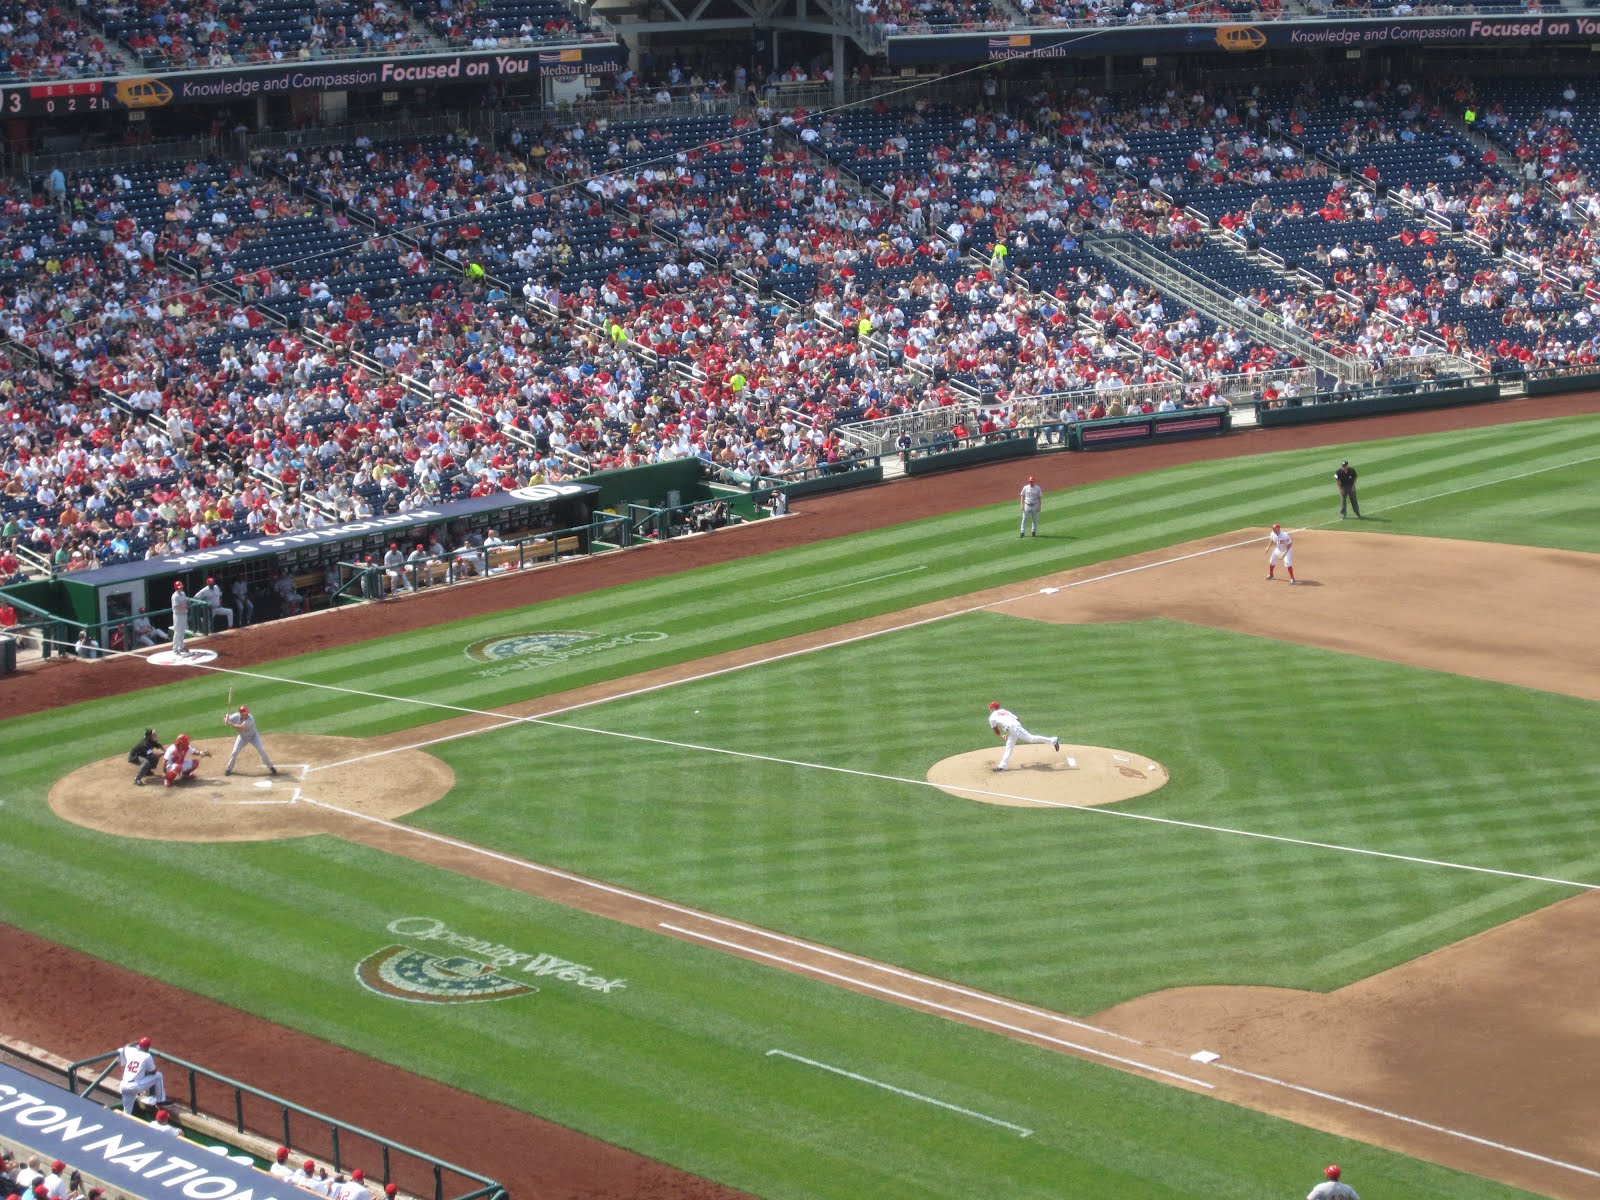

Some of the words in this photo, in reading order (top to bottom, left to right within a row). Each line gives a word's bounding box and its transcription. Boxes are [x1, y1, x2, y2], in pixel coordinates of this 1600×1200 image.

[1291, 28, 1360, 44] Knowledge
[1364, 27, 1388, 40] and
[1391, 26, 1466, 42] Compassion
[1470, 19, 1543, 37] Focused
[1548, 23, 1569, 35] on
[989, 48, 1031, 60] MedStar
[1033, 46, 1067, 58] Health
[183, 77, 260, 97] Knowledge
[263, 74, 290, 91] and
[292, 70, 377, 88] Compassion
[381, 58, 461, 82] Focused
[466, 62, 489, 75] on
[495, 56, 529, 74] You
[540, 64, 582, 77] MedStar
[584, 61, 618, 73] Health
[68, 84, 75, 94] S
[9, 93, 21, 113] 3
[46, 100, 55, 112] 0
[68, 99, 76, 111] 2
[89, 97, 97, 109] 2
[258, 509, 441, 548] NATIONALS
[164, 544, 259, 565] PARK
[128, 1061, 140, 1073] 42
